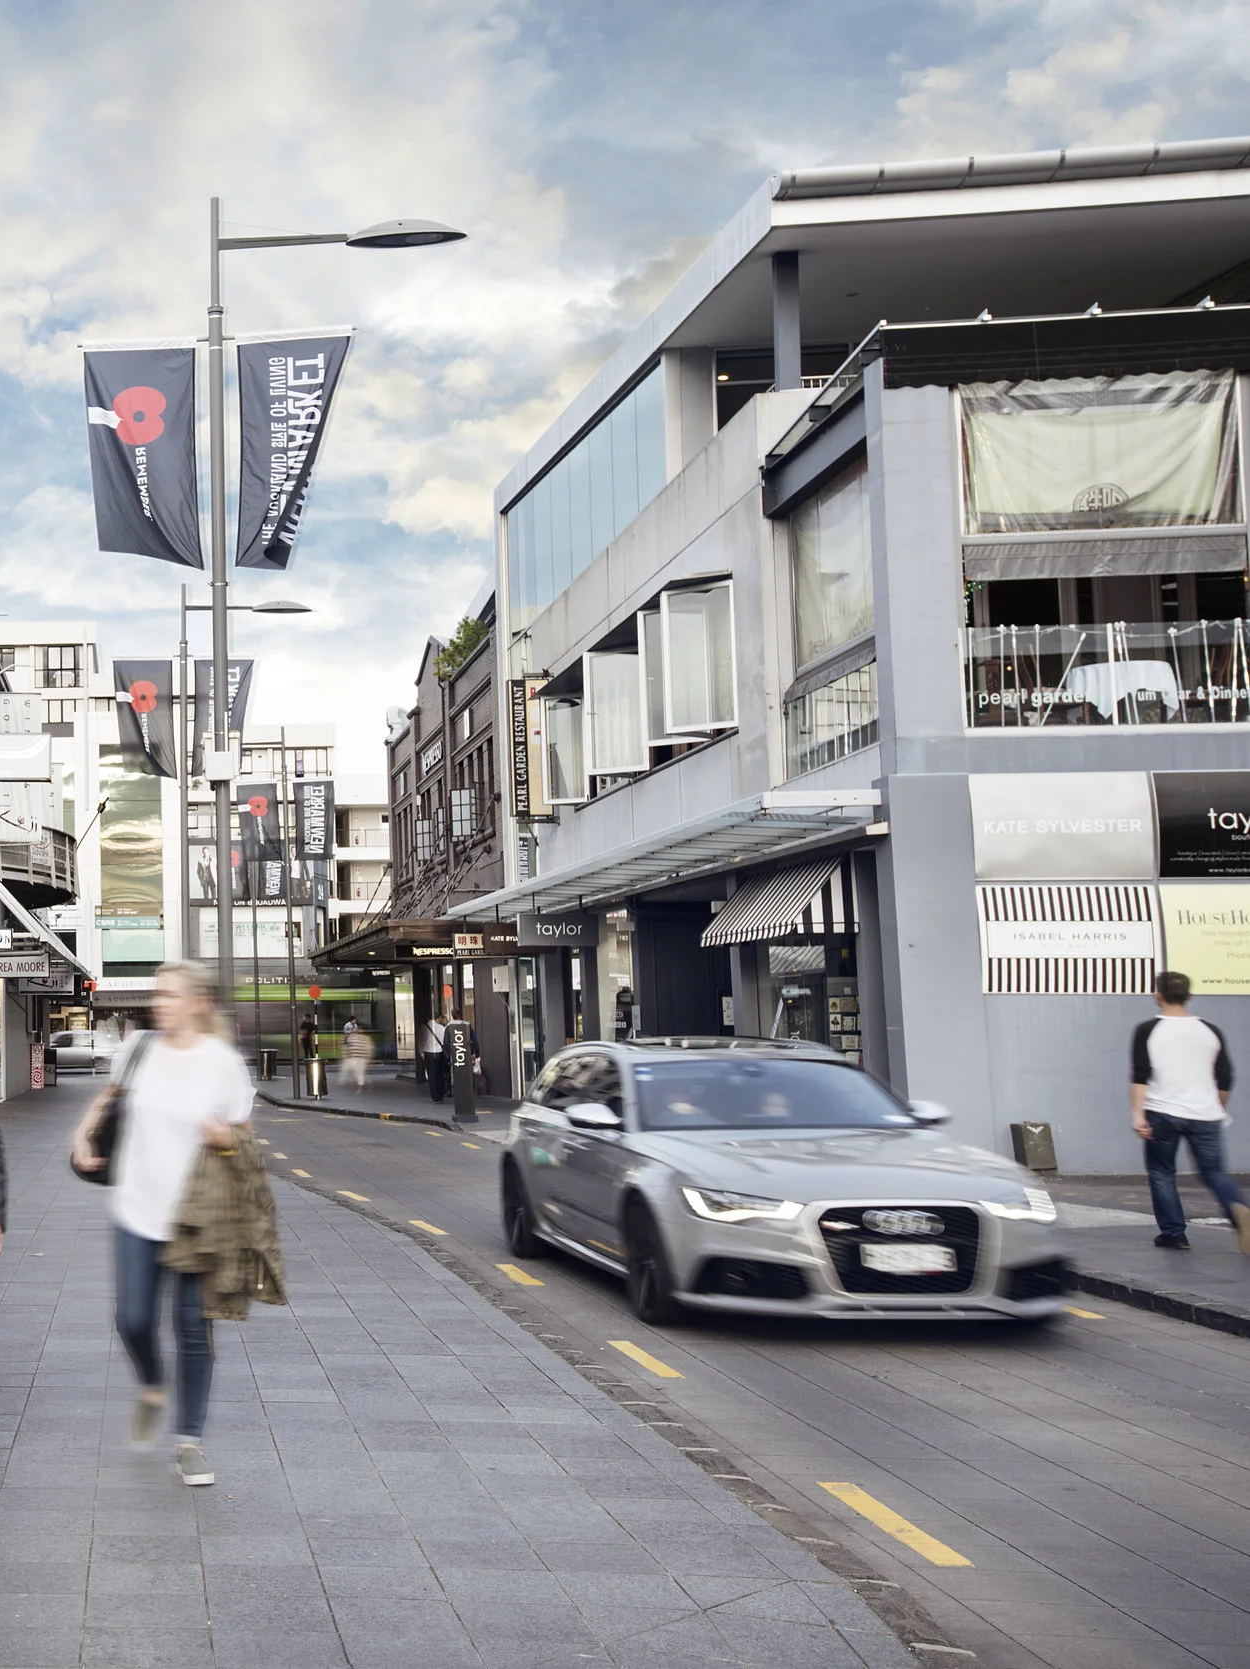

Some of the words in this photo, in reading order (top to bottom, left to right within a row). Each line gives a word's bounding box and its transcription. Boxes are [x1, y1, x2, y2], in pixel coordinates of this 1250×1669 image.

[978, 689, 1028, 708] pearl
[1031, 687, 1090, 707] garde
[513, 686, 526, 743] RESTAURANT
[515, 748, 527, 781] GARDEN
[517, 782, 528, 812] PEARL
[983, 820, 1030, 835] KATE
[1035, 818, 1143, 834] SYLVESTER
[535, 921, 583, 938] taylor
[1013, 932, 1065, 941] ISABEL
[1072, 932, 1127, 941] HARRIS
[16, 961, 46, 973] MOORE
[245, 976, 292, 984] POLITI
[454, 1028, 467, 1067] taylor
